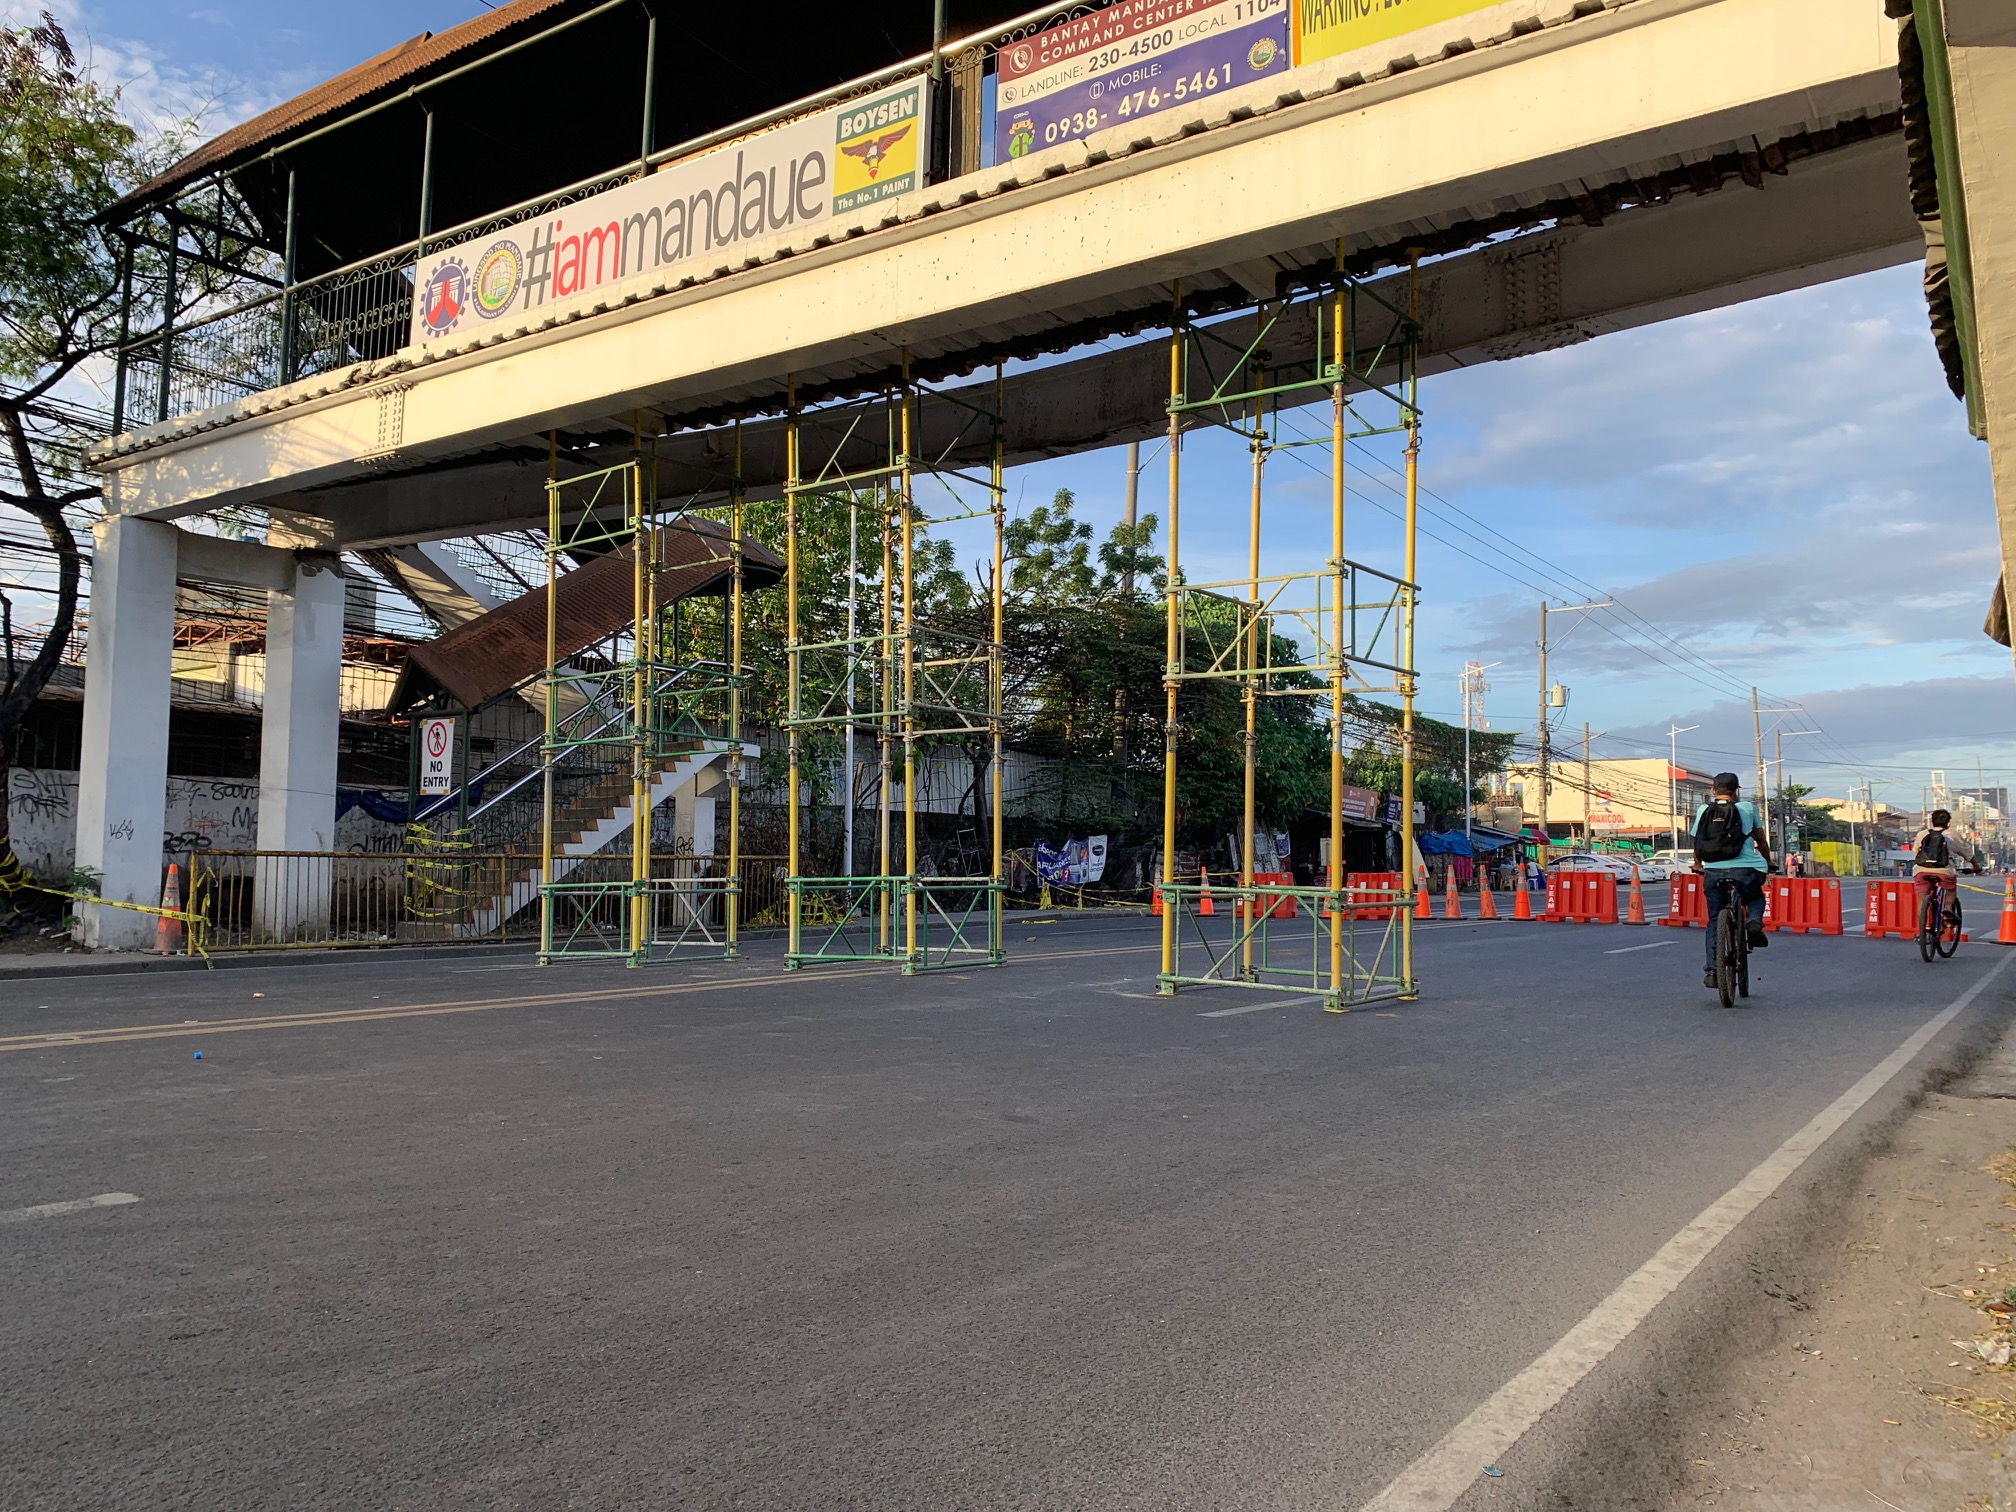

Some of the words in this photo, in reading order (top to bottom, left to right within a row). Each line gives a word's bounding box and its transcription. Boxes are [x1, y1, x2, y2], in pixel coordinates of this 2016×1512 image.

[1040, 24, 1125, 63] COMMAND
[1133, 0, 1194, 29] CENTER
[1041, 16, 1101, 48] BANTAY
[1021, 65, 1083, 98] LANDLINE:
[1088, 29, 1173, 73] 230-4500
[1178, 14, 1228, 41] LOCAL
[1108, 63, 1162, 91] MOBILE:
[841, 94, 914, 139] BOYSEN
[1045, 108, 1108, 143] 0938-
[1118, 62, 1231, 117] 476-5461
[838, 197, 853, 210] The
[882, 178, 910, 196] PAINT
[522, 150, 826, 310] #iammandaue
[505, 241, 523, 280] MANDAUE
[429, 760, 443, 773] NO
[422, 776, 450, 788] ENTRY
[1590, 814, 1626, 824] MAXICOOL
[1547, 884, 1555, 909] TEAM
[1671, 887, 1680, 913] TEAM
[1762, 891, 1771, 917] TEAM
[1869, 895, 1878, 923] TEAM
